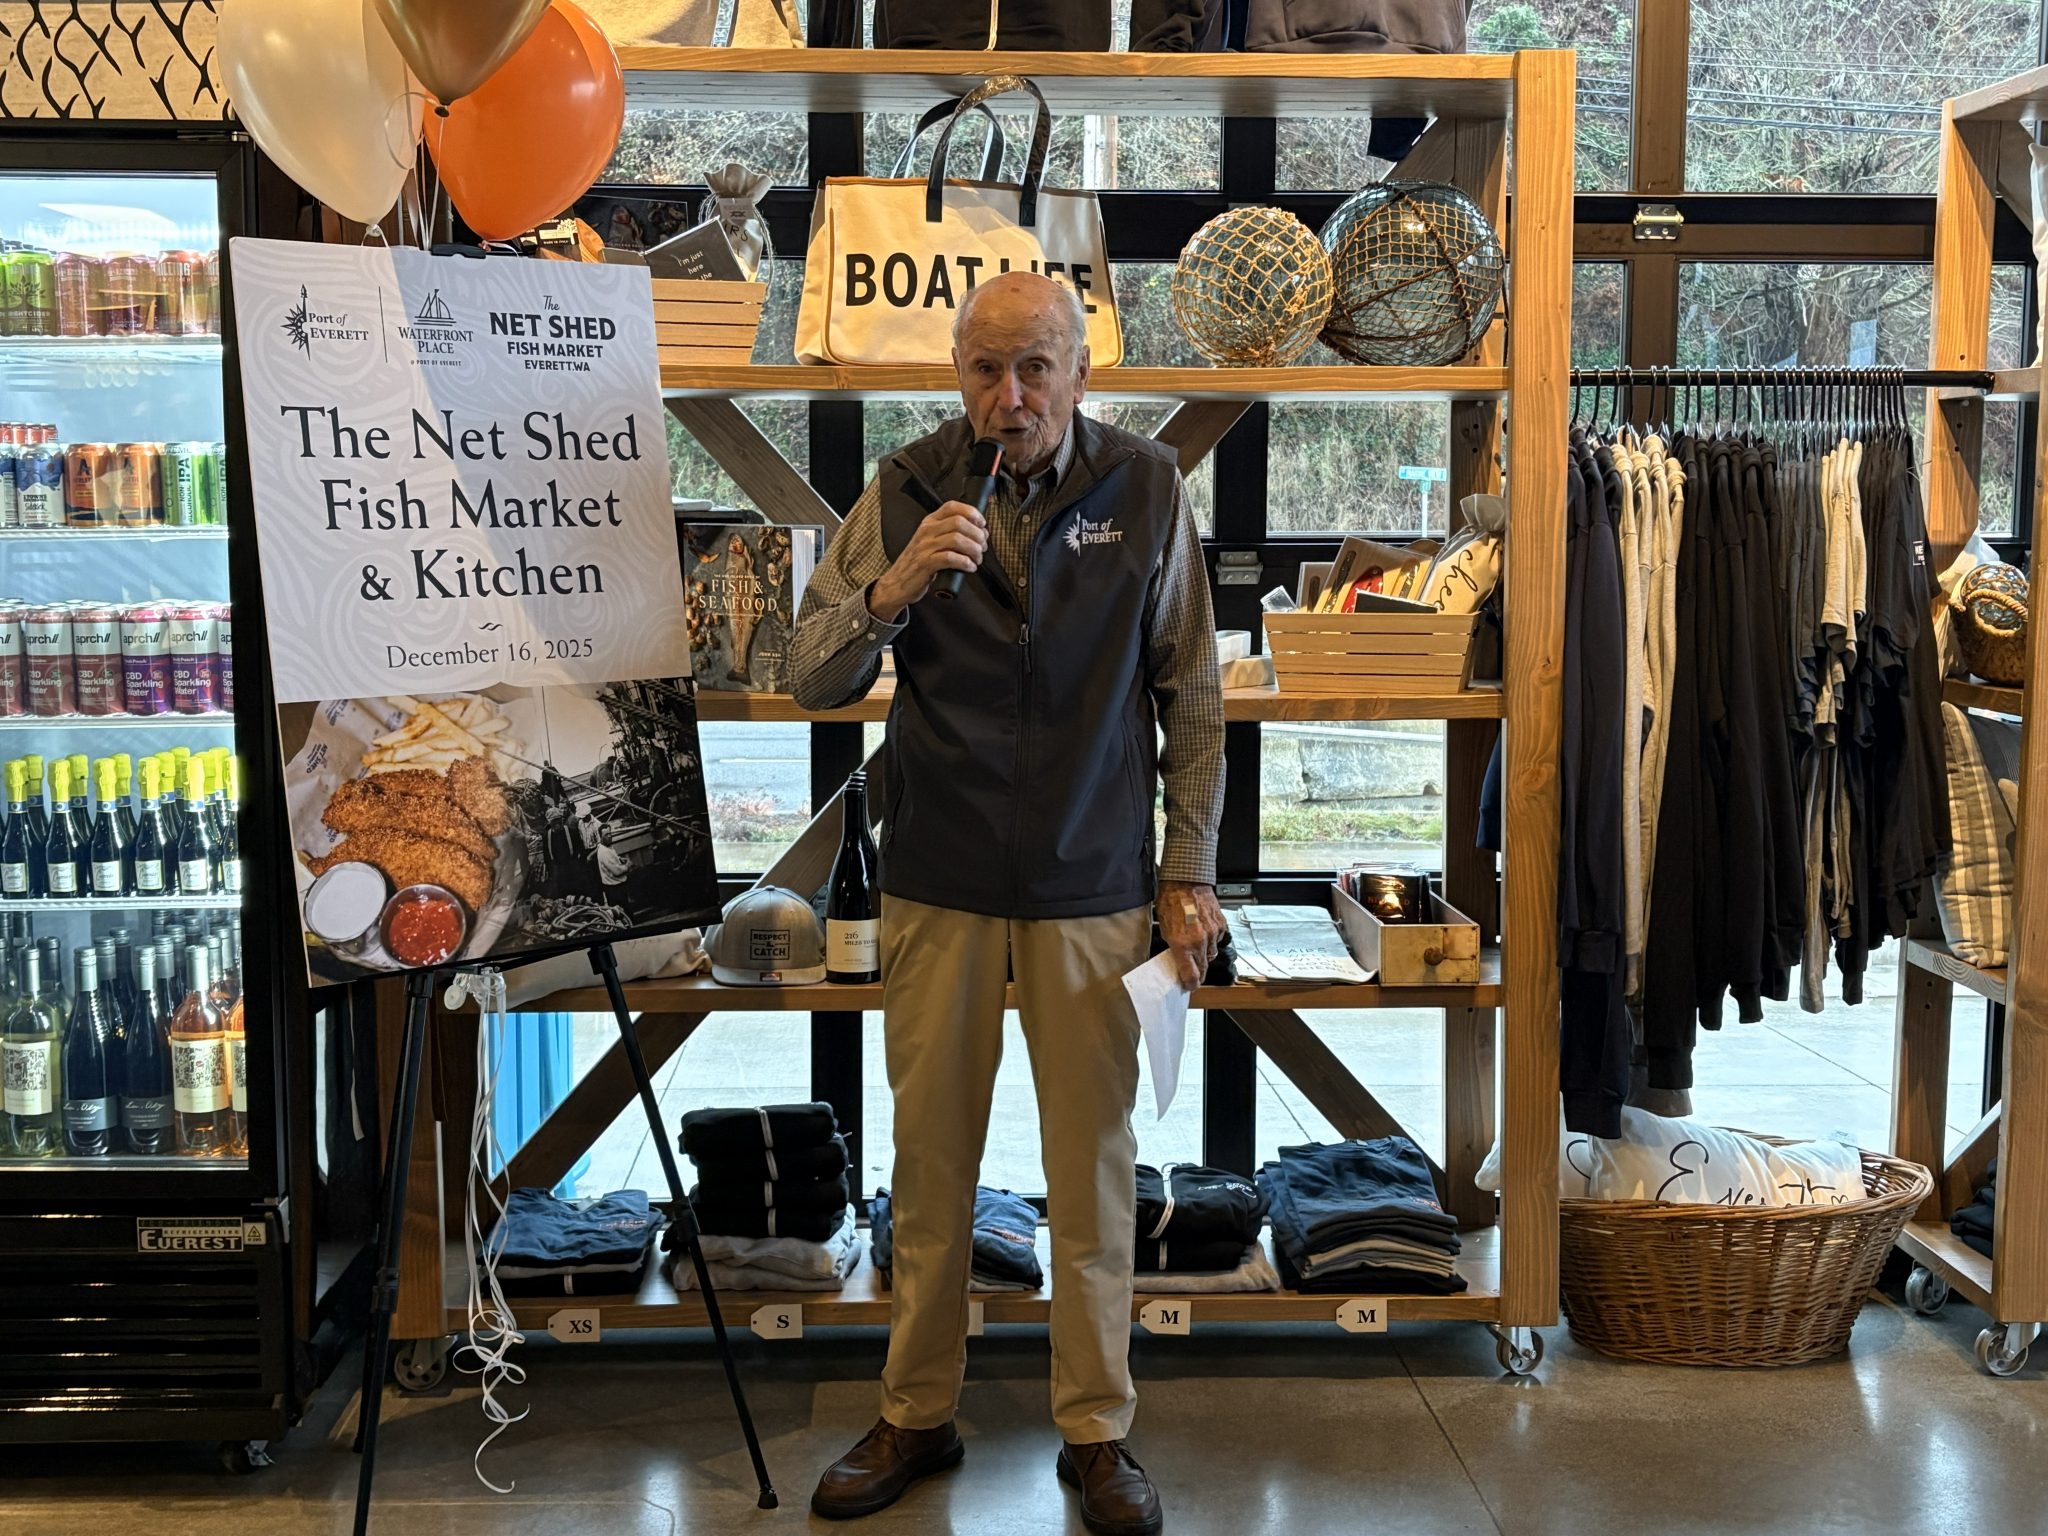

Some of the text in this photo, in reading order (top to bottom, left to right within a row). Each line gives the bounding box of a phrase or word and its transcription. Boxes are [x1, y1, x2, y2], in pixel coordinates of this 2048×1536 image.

[677, 250, 704, 267] I'm just
[688, 263, 704, 275] here
[845, 252, 984, 309] BOAT
[543, 295, 560, 311] The
[309, 313, 348, 327] Port of
[489, 312, 616, 340] NET SHED
[310, 327, 369, 341] EVERETT
[398, 326, 474, 342] WATERFRONT
[417, 340, 454, 354] PLACE
[507, 341, 603, 358] FISH MARKET
[281, 405, 641, 462] The Net Shed
[178, 457, 191, 482] IPA
[320, 478, 622, 531] Fish Market
[1081, 518, 1113, 532] Port of
[1081, 531, 1123, 545] EVERETT
[360, 548, 604, 602] & Kitchen
[711, 579, 764, 595] FISH &
[699, 595, 778, 612] SEAFOOD
[387, 638, 594, 669] December 16, 2025
[126, 672, 142, 680] CBD
[174, 670, 190, 679] CBD
[127, 679, 164, 689] Sparkling
[174, 678, 212, 689] Sparkling
[174, 686, 198, 695] Water
[128, 688, 150, 697] Water
[753, 933, 788, 941] RESPECT
[753, 948, 786, 957] CATCH
[141, 1230, 240, 1250] EVEREST
[776, 1314, 790, 1329] S
[1160, 1310, 1179, 1325] M
[1357, 1309, 1376, 1324] M
[568, 1318, 593, 1334] XS
